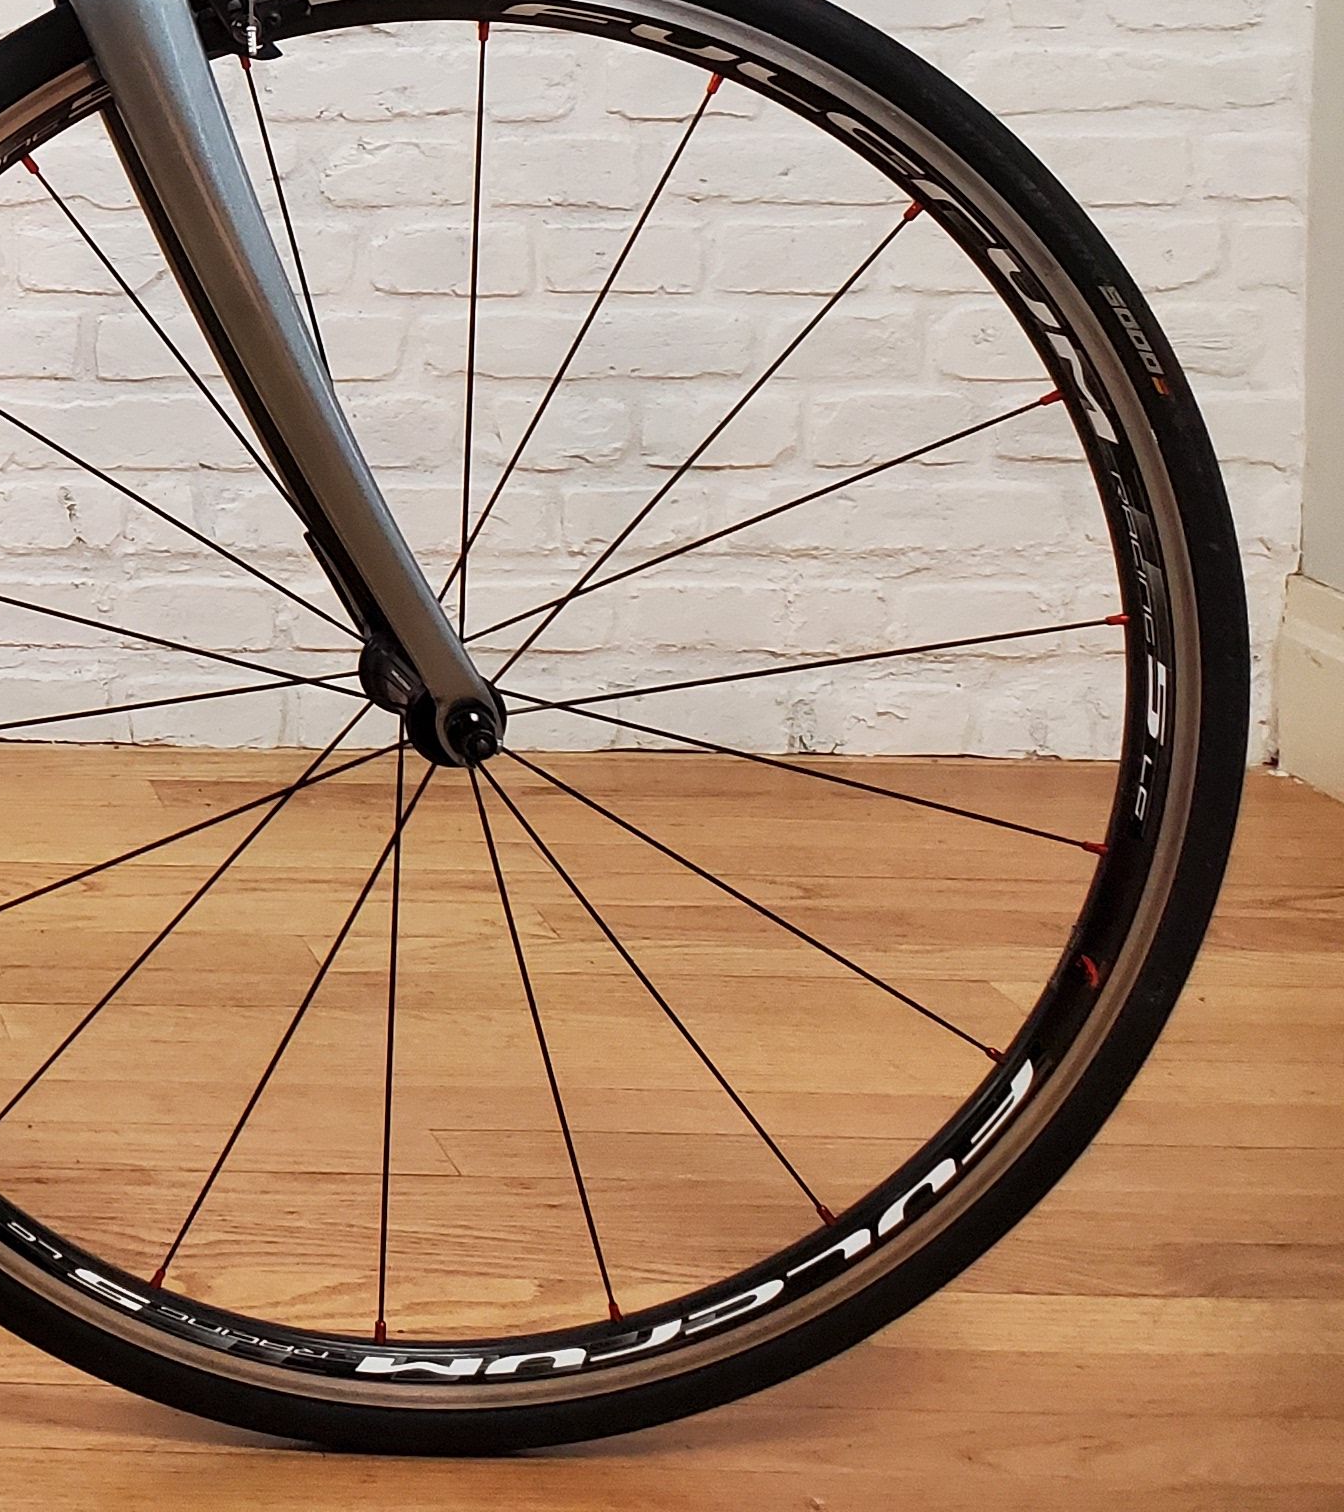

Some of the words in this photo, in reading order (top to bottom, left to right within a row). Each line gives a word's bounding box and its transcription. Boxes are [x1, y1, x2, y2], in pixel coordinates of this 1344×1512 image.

[502, 3, 1119, 445] FULCRUM
[1097, 285, 1165, 375] 5000
[1146, 653, 1167, 747] 5
[354, 1058, 1035, 1382] FULCRUM
[66, 1267, 152, 1313] 5
